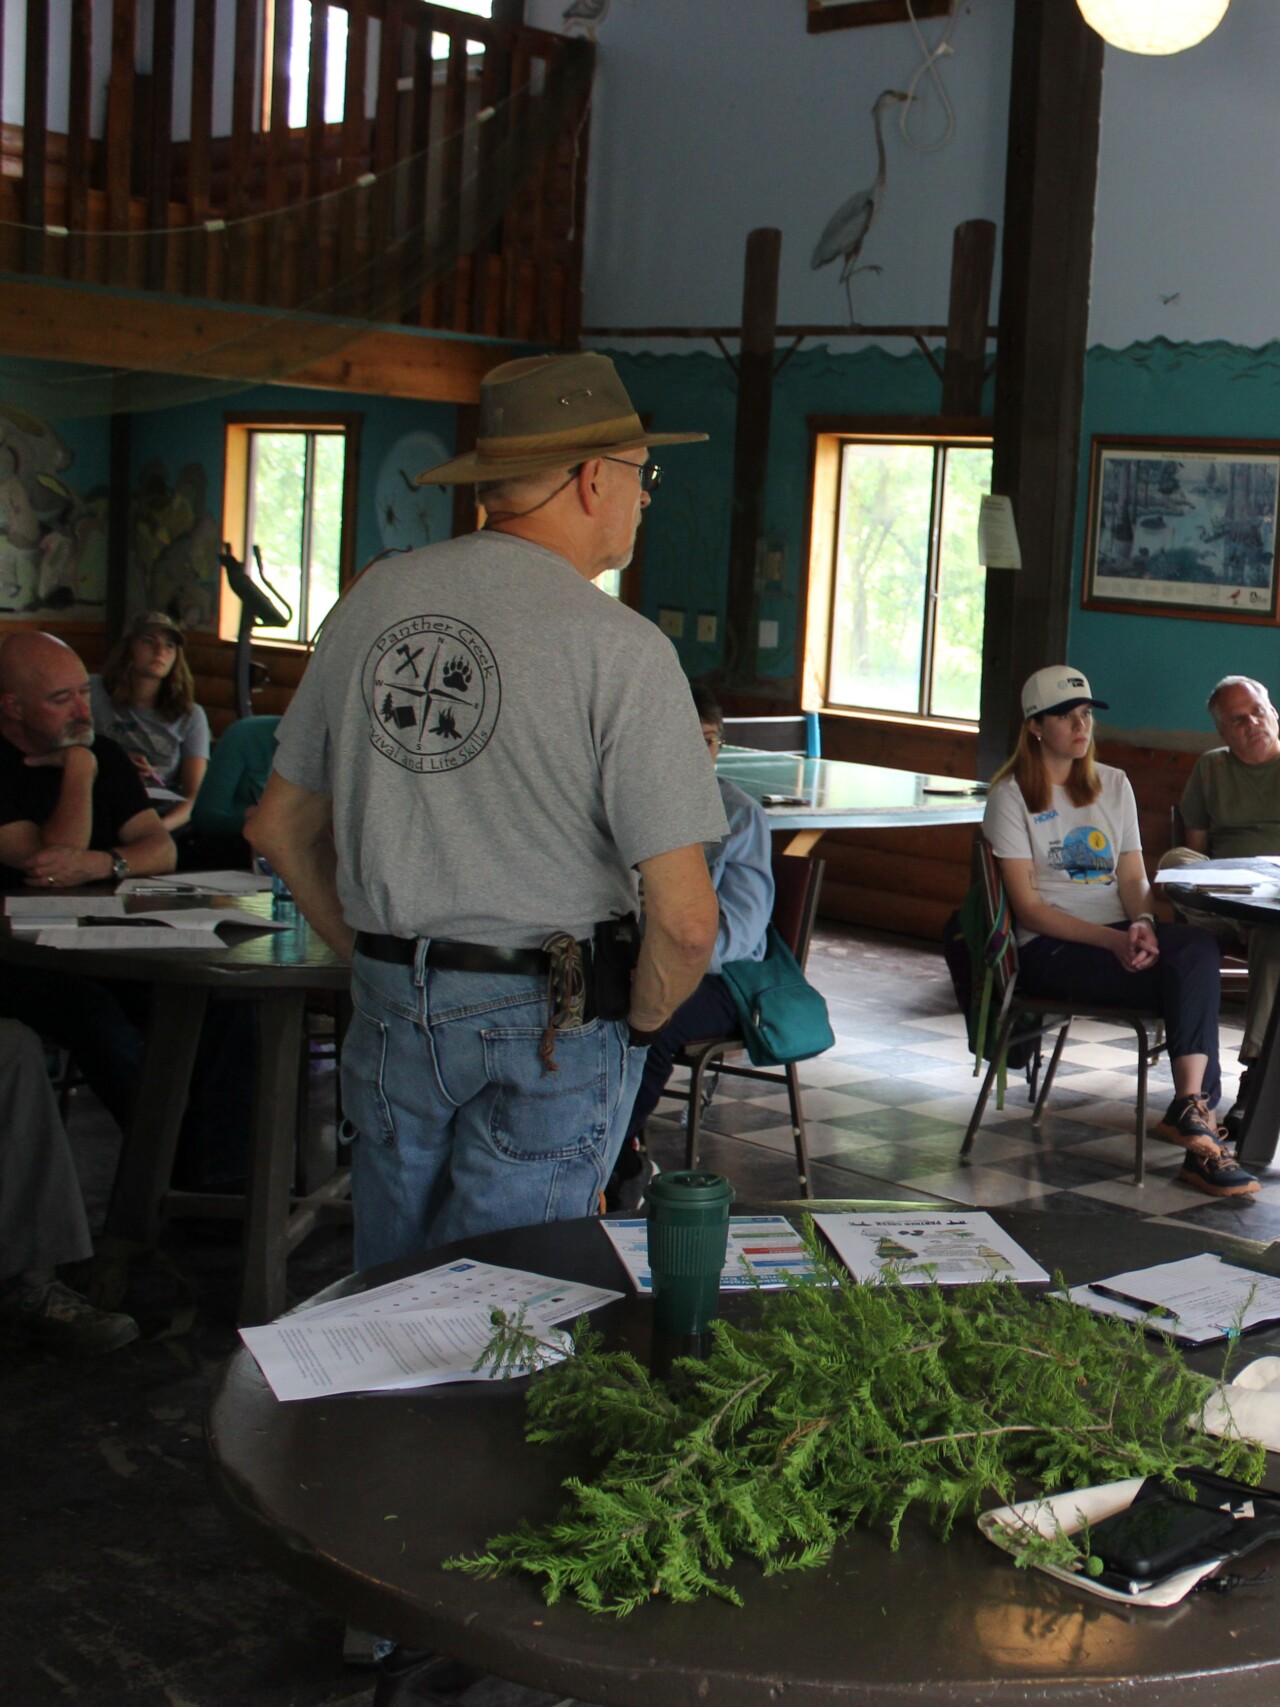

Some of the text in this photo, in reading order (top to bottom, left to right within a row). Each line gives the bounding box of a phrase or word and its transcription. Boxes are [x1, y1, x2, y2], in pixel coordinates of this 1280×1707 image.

[437, 637, 444, 645] N
[376, 618, 495, 680] Panther Creek
[375, 679, 383, 687] W
[402, 755, 423, 771] and
[431, 752, 458, 770] Life
[459, 730, 488, 762] Skills
[416, 743, 422, 751] S
